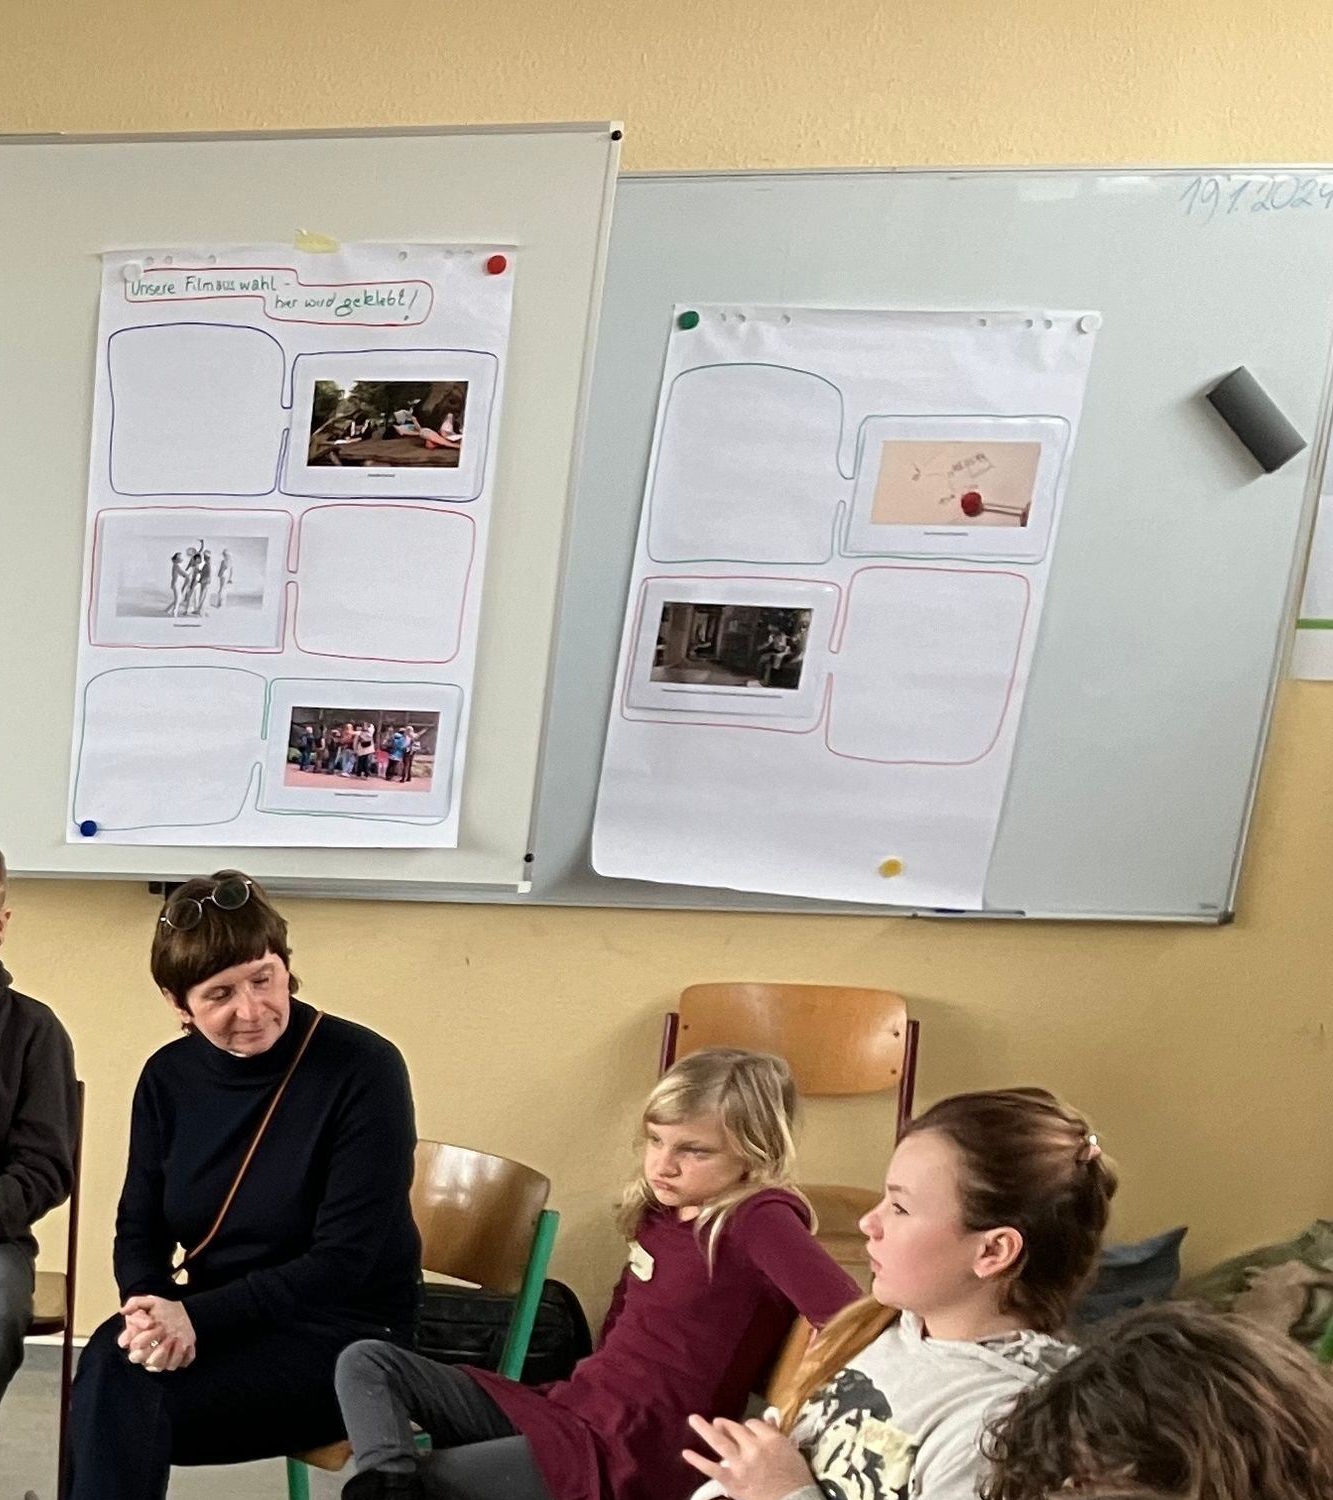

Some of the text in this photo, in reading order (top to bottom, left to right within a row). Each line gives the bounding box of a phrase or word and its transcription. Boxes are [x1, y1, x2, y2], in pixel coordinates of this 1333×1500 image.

[131, 279, 176, 297] Unsere
[274, 294, 298, 310] hier
[304, 293, 336, 309] wird
